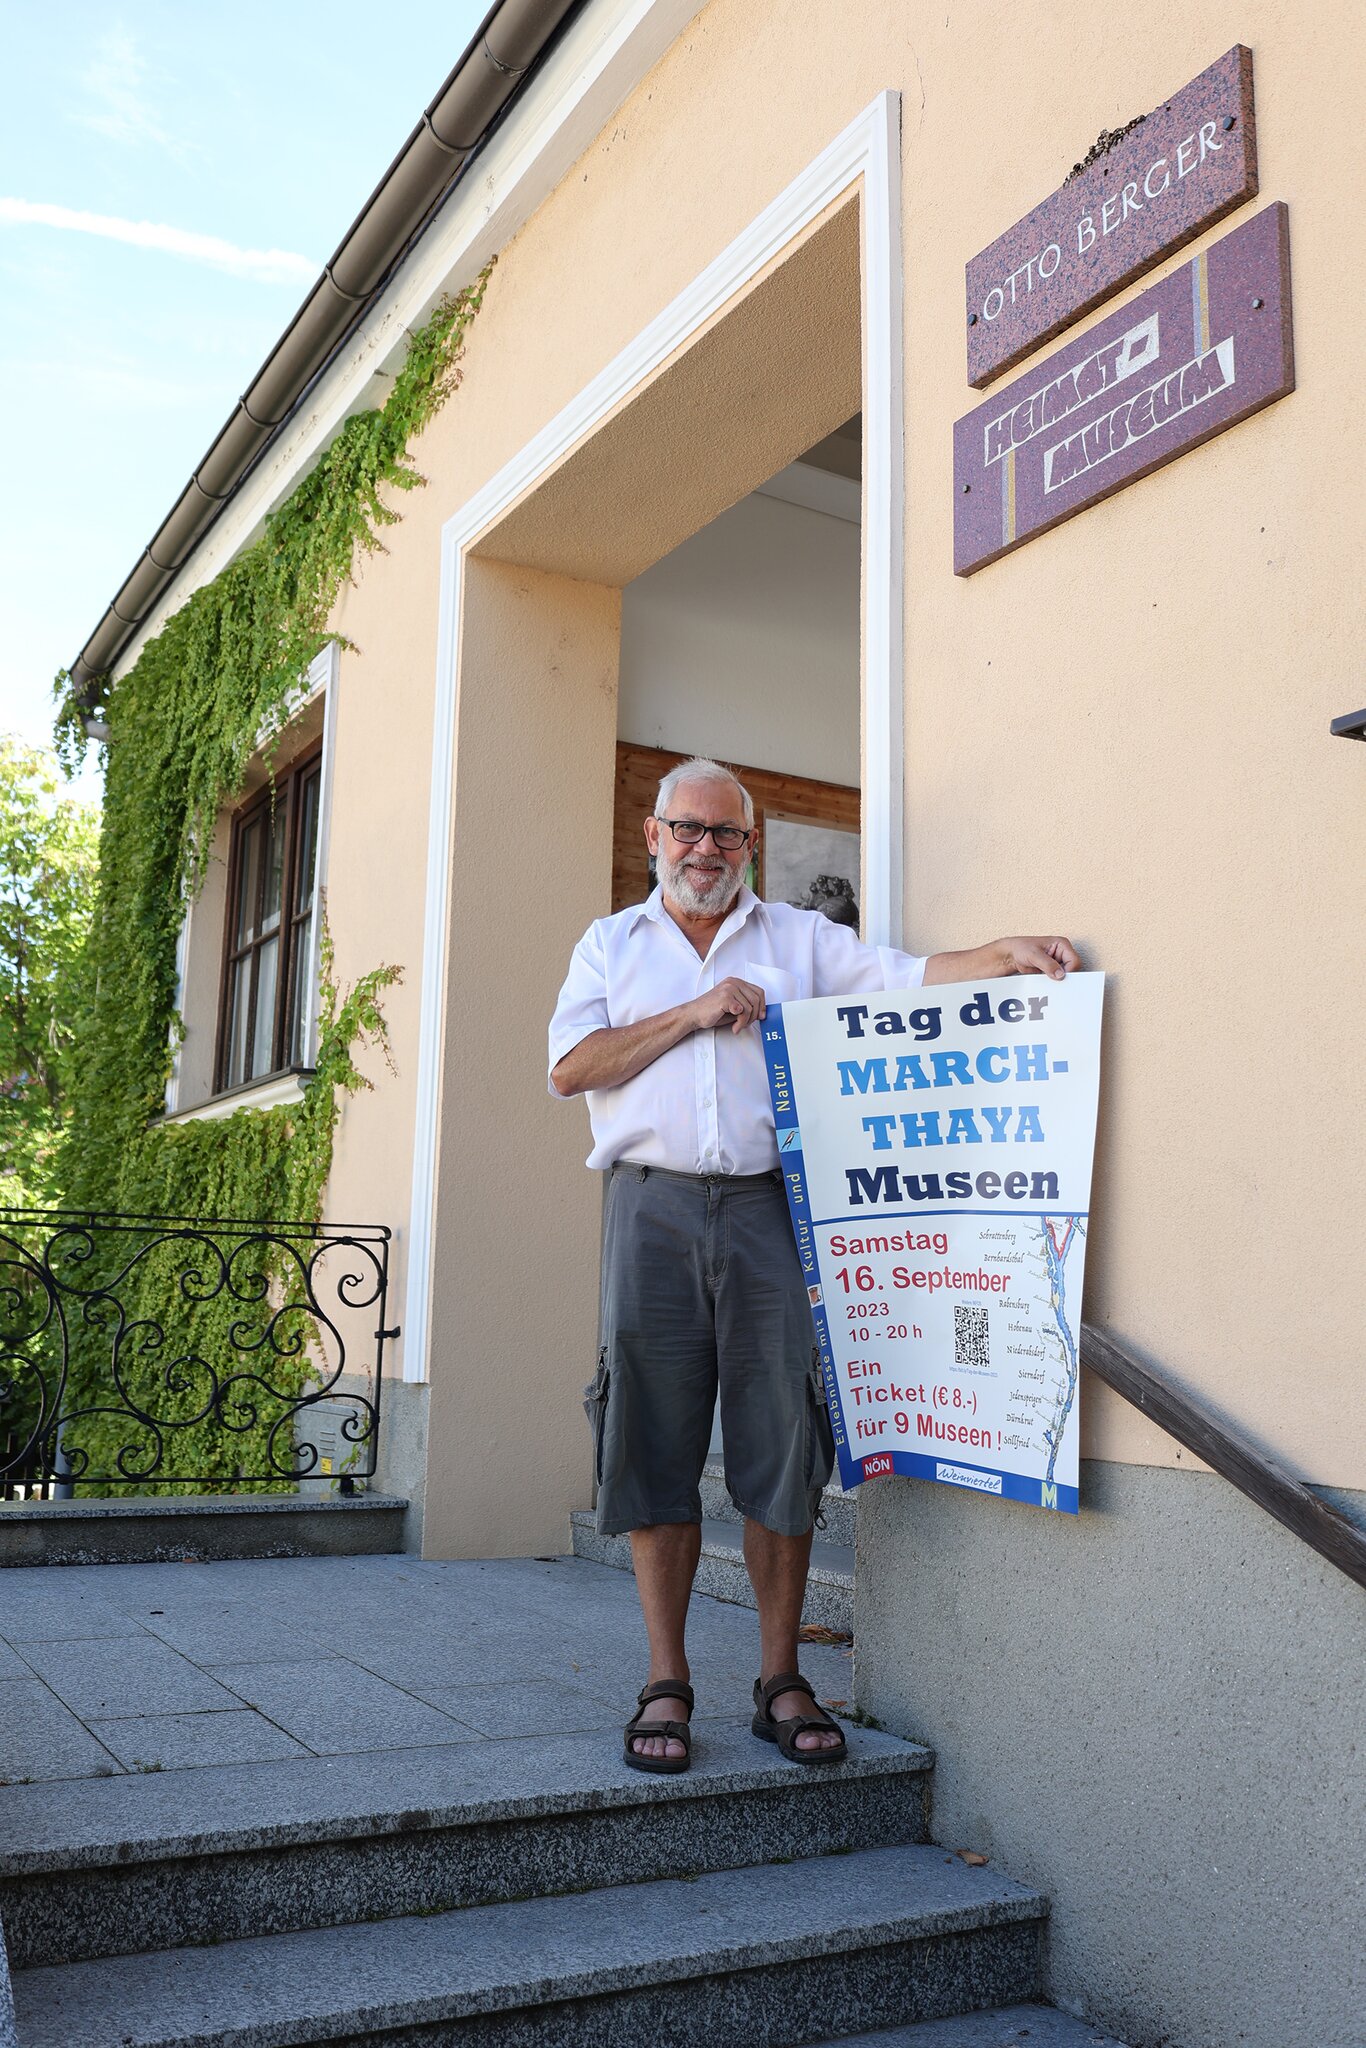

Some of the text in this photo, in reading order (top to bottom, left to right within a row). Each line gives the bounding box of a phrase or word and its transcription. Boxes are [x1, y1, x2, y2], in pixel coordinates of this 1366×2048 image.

[983, 120, 1223, 322] OTTO BERGER
[985, 334, 1127, 467] HEIMAT
[1044, 336, 1236, 494] MUSEUM
[837, 992, 1049, 1041] Tag der
[765, 1031, 782, 1041] 15.
[836, 1043, 1069, 1096] MARCH-
[862, 1105, 1045, 1151] THAYA
[845, 1165, 1060, 1206] Museen
[775, 1063, 845, 1446] Erlebnisse mit Kultur und Natur
[829, 1230, 949, 1257] Samstag
[835, 1265, 884, 1294] 16.
[893, 1266, 1011, 1294] September
[846, 1302, 890, 1319] 2023
[849, 1328, 870, 1342] 10
[886, 1325, 908, 1340] 20
[912, 1325, 923, 1339] h
[847, 1359, 882, 1379] Ein
[850, 1383, 926, 1406] Ticket
[856, 1418, 888, 1440] für
[893, 1412, 910, 1435] 9
[916, 1413, 992, 1449] Museen
[864, 1457, 891, 1476] NÖN
[937, 1466, 1002, 1491] Weinviertel
